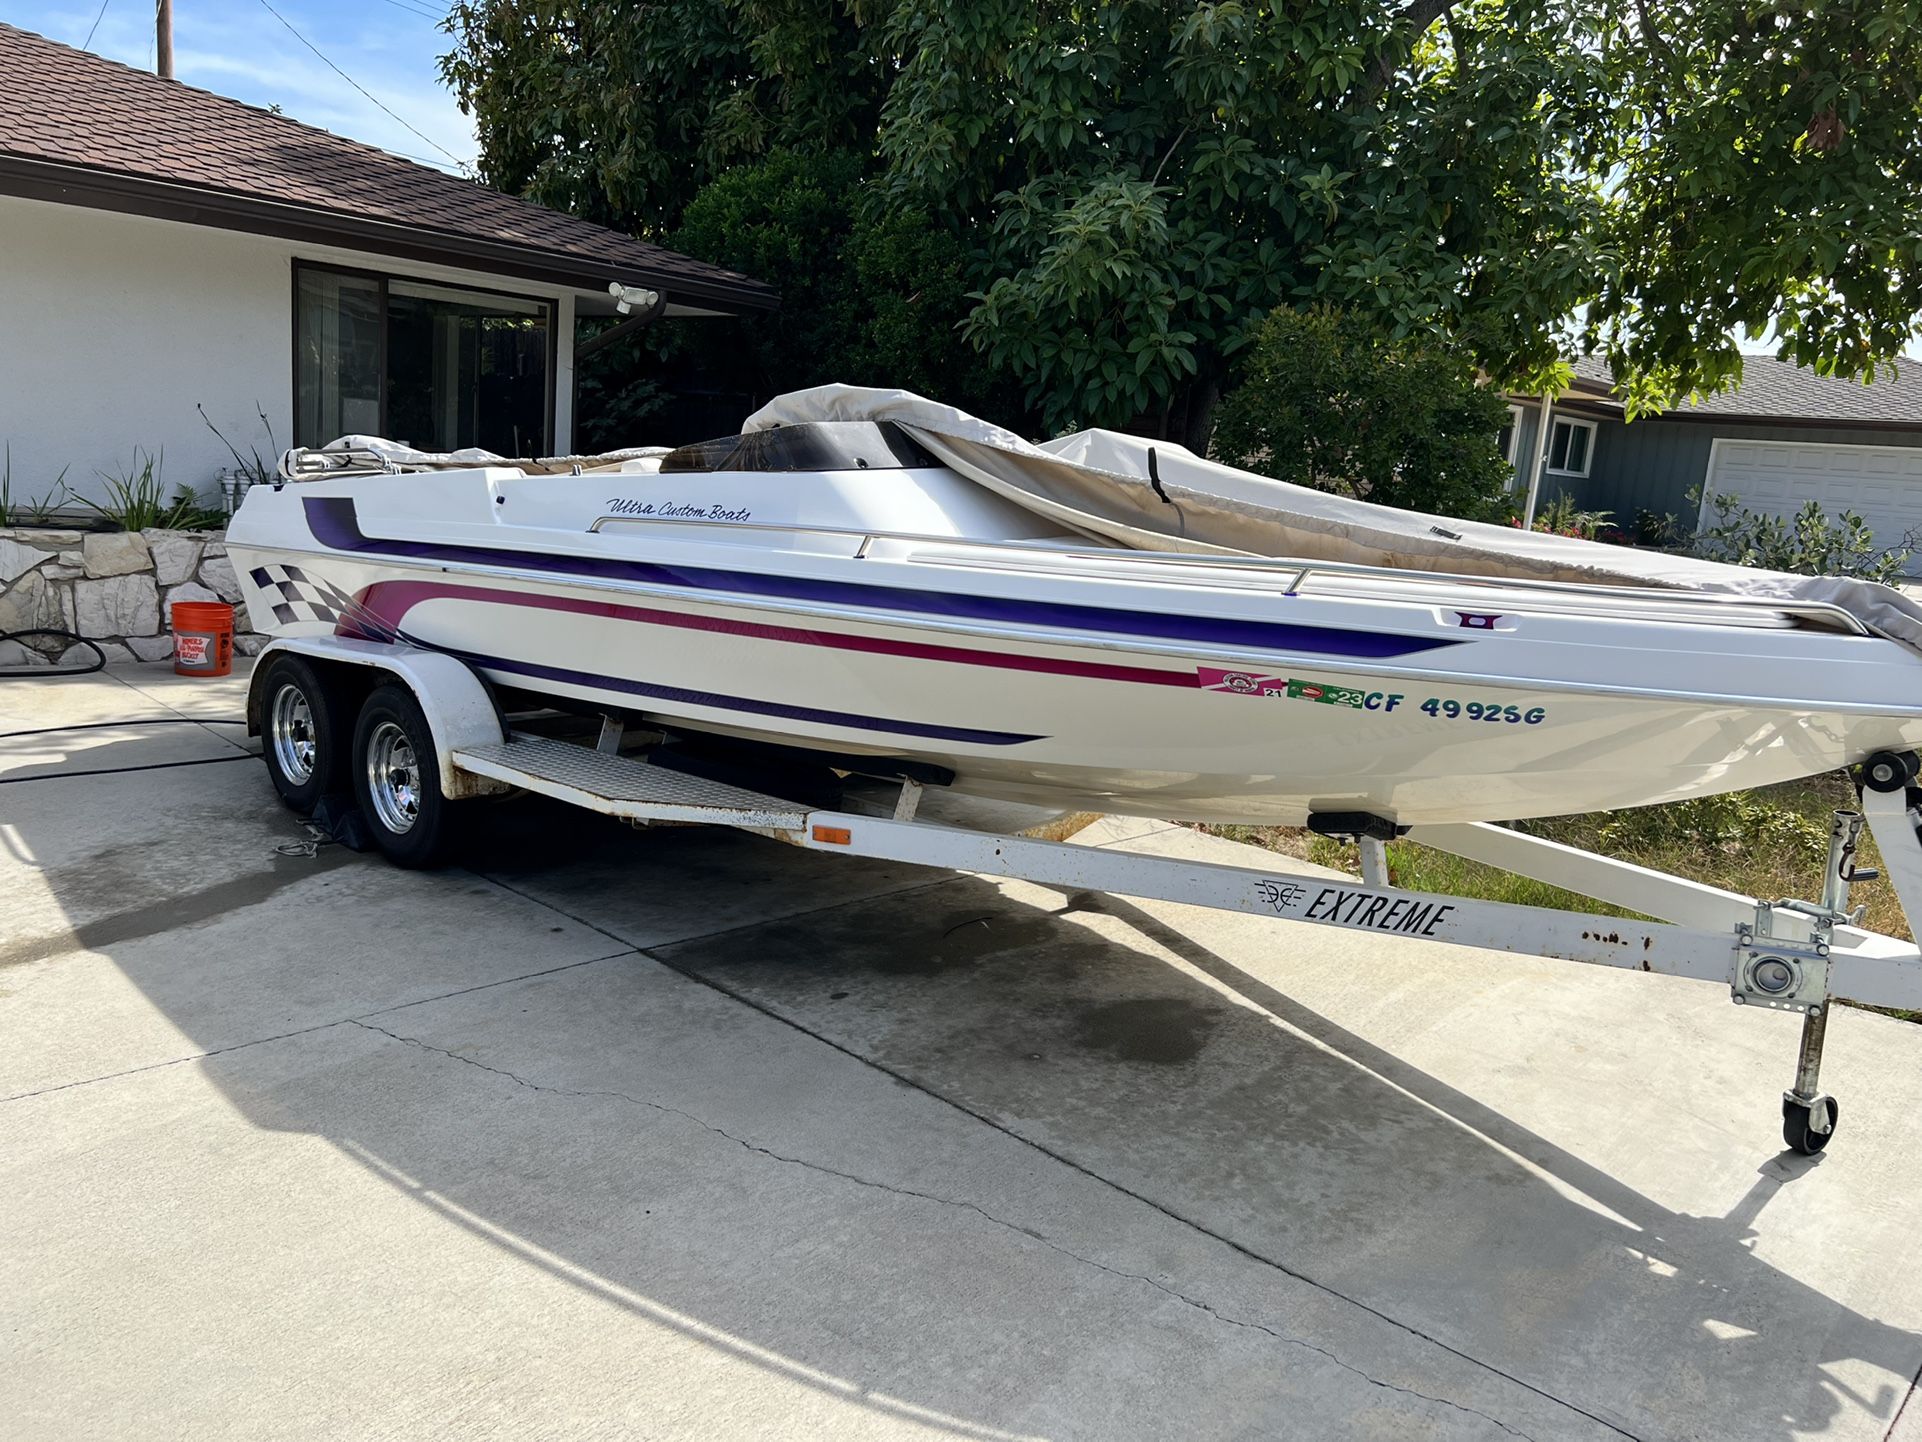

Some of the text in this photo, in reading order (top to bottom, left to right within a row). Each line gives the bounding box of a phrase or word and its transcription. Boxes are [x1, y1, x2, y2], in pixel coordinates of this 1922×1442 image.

[606, 498, 751, 522] Ultra Custom Boats
[1265, 688, 1282, 698] 21
[1338, 691, 1363, 706] 23
[1364, 691, 1405, 712] CF
[1304, 888, 1455, 936] EXTREME
